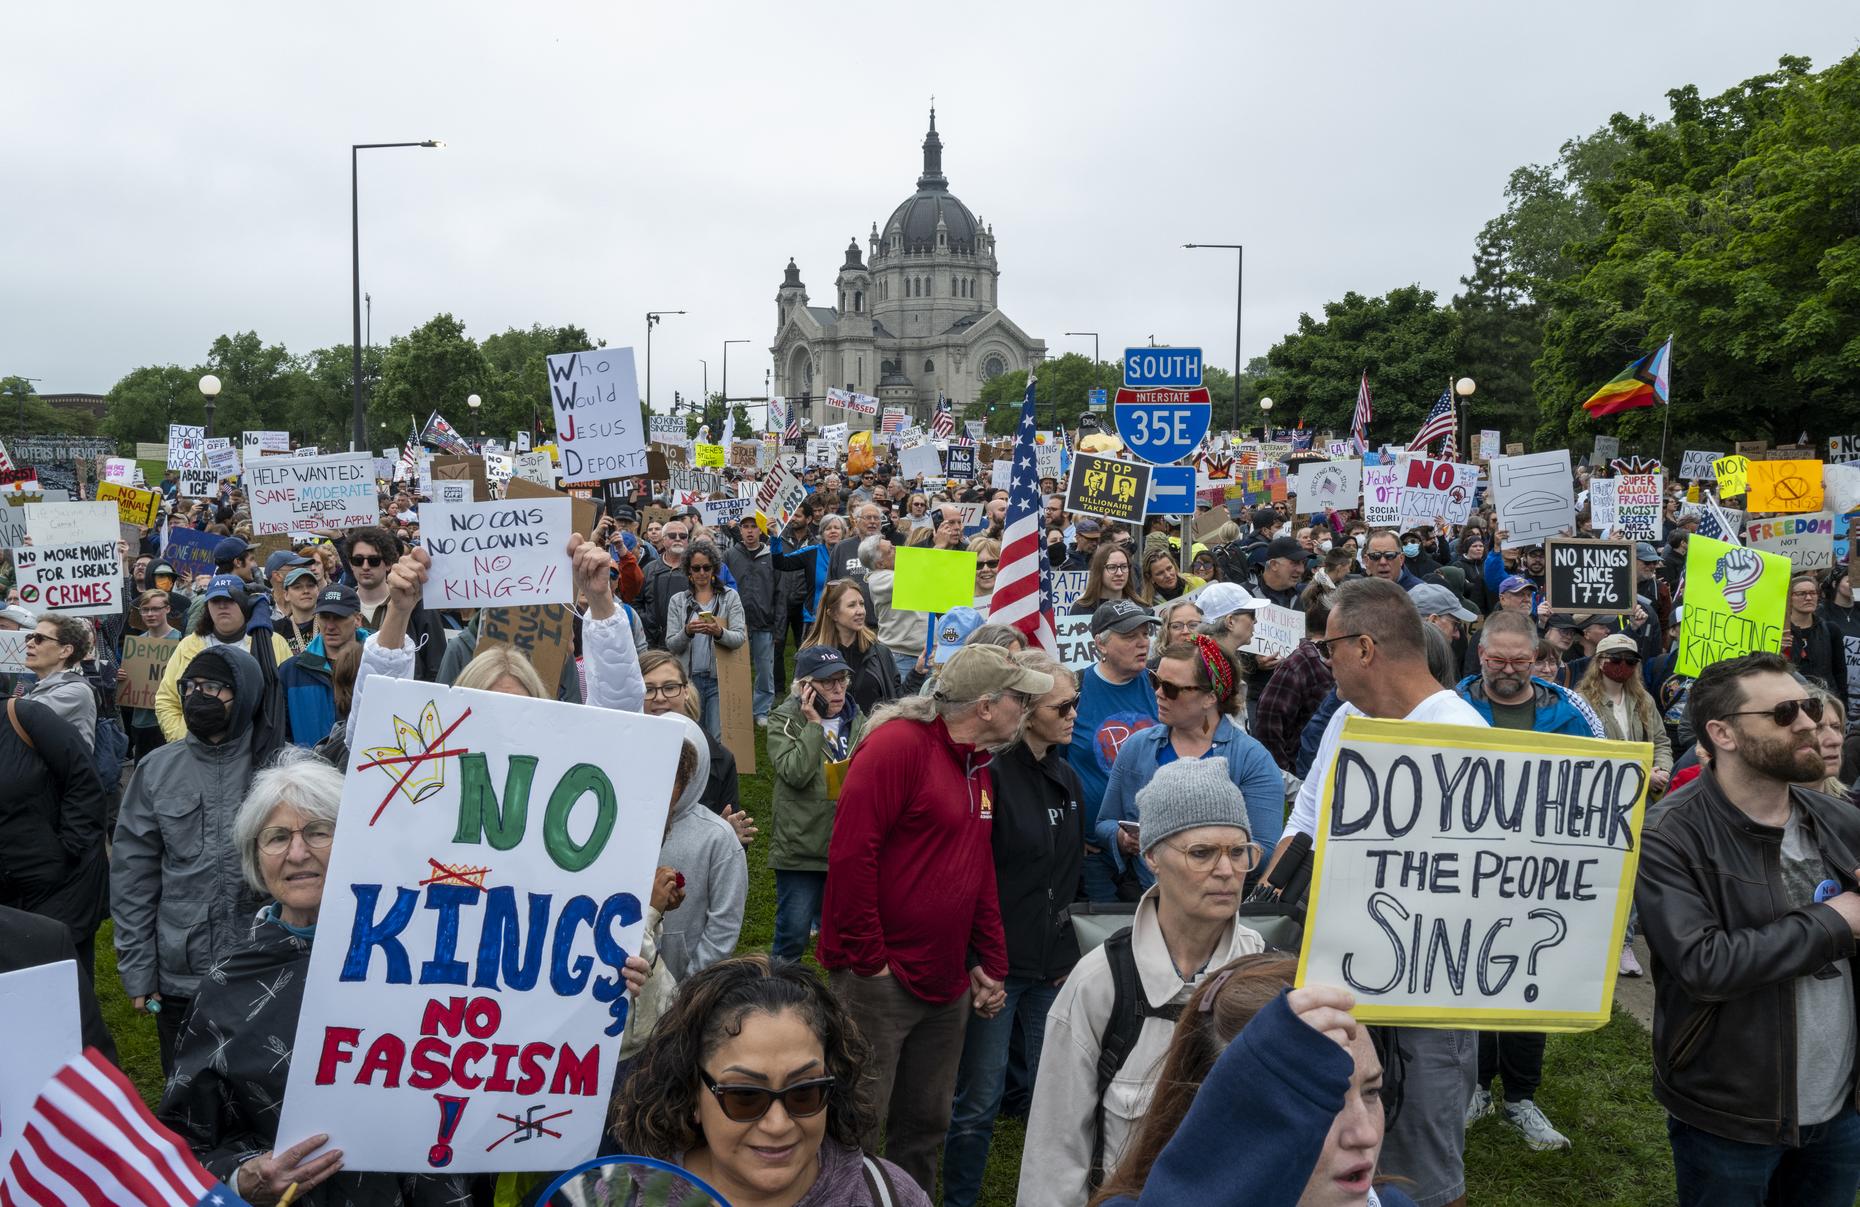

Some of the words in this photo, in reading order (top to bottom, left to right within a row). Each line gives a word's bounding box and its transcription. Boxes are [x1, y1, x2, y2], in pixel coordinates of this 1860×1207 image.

[548, 353, 610, 383] Who
[1129, 355, 1199, 379] SOUTH
[554, 382, 616, 411] Would
[1136, 392, 1190, 403] INTERSTATE
[828, 397, 846, 408] THIS
[847, 401, 876, 415] PISSED
[650, 417, 663, 425] NO
[663, 417, 684, 425] KING
[650, 424, 673, 433] SINCE
[1130, 410, 1192, 446] 35E
[170, 425, 204, 438] FUCK
[169, 449, 201, 461] FUCK
[660, 443, 677, 458] NO
[1330, 443, 1347, 454] EAT
[487, 455, 503, 464] NO
[519, 455, 545, 467] STOP
[565, 448, 646, 476] DEPORT?
[1684, 452, 1703, 464] NO
[252, 468, 289, 486] HELP
[291, 464, 365, 482] WANTED:
[950, 462, 972, 472] KINGS
[1093, 459, 1133, 475] STOP
[1406, 458, 1455, 491] NO
[1715, 460, 1738, 478] NO
[182, 469, 218, 484] ABOLISH
[1623, 476, 1656, 486] SUPER
[119, 487, 137, 500] NO
[190, 483, 208, 495] ICE
[255, 488, 301, 505] SANE,
[302, 483, 373, 500] MODERATE
[756, 460, 787, 513] CRUELTY
[1618, 485, 1657, 494] CALLOUS
[292, 499, 347, 513] LEADERS
[705, 498, 751, 512] PRESIDENTS
[1079, 495, 1133, 512] BILLIONAIRE
[1401, 490, 1471, 524] KINGS
[1619, 495, 1661, 505] FRAGILE
[729, 508, 744, 516] NOT
[1082, 503, 1129, 518] TAKEOVER
[1619, 505, 1659, 516] RACIST
[259, 522, 289, 535] KINGS
[292, 519, 319, 530] NEED
[321, 518, 340, 528] NOT
[344, 514, 373, 526] APPLY
[450, 513, 485, 532] NO
[489, 508, 544, 528] CONS
[1619, 515, 1657, 524] SEXIST
[1624, 523, 1651, 531] NAZI
[1619, 530, 1655, 540] POTUS
[1748, 518, 1833, 543] FREEDOM
[426, 537, 457, 556] NO
[461, 531, 549, 553] CLOWNS
[1780, 538, 1799, 547] NOT
[18, 552, 37, 565] NO
[44, 548, 78, 562] MORE
[80, 542, 117, 561] MONEY
[1554, 548, 1578, 567] NO
[1583, 548, 1629, 567] KINGS
[37, 566, 65, 584] FOR
[72, 562, 118, 579] ISREAL'S
[474, 555, 512, 576] NO
[214, 579, 232, 587] ART
[444, 565, 557, 601] KINGS!!
[1572, 567, 1614, 583] SINCE
[45, 581, 112, 607] CRIMES
[1571, 583, 1619, 604] 1776
[1683, 603, 1781, 656] REJECTING
[1330, 748, 1423, 838] DO
[1431, 753, 1532, 833] YOU
[1535, 758, 1647, 850] HEAR
[451, 752, 618, 873] NO
[1366, 849, 1461, 894] THE
[1471, 850, 1599, 900] PEOPLE
[1341, 892, 1567, 1003] SING?
[420, 996, 502, 1040] NO
[315, 1025, 601, 1097] FASCISM
